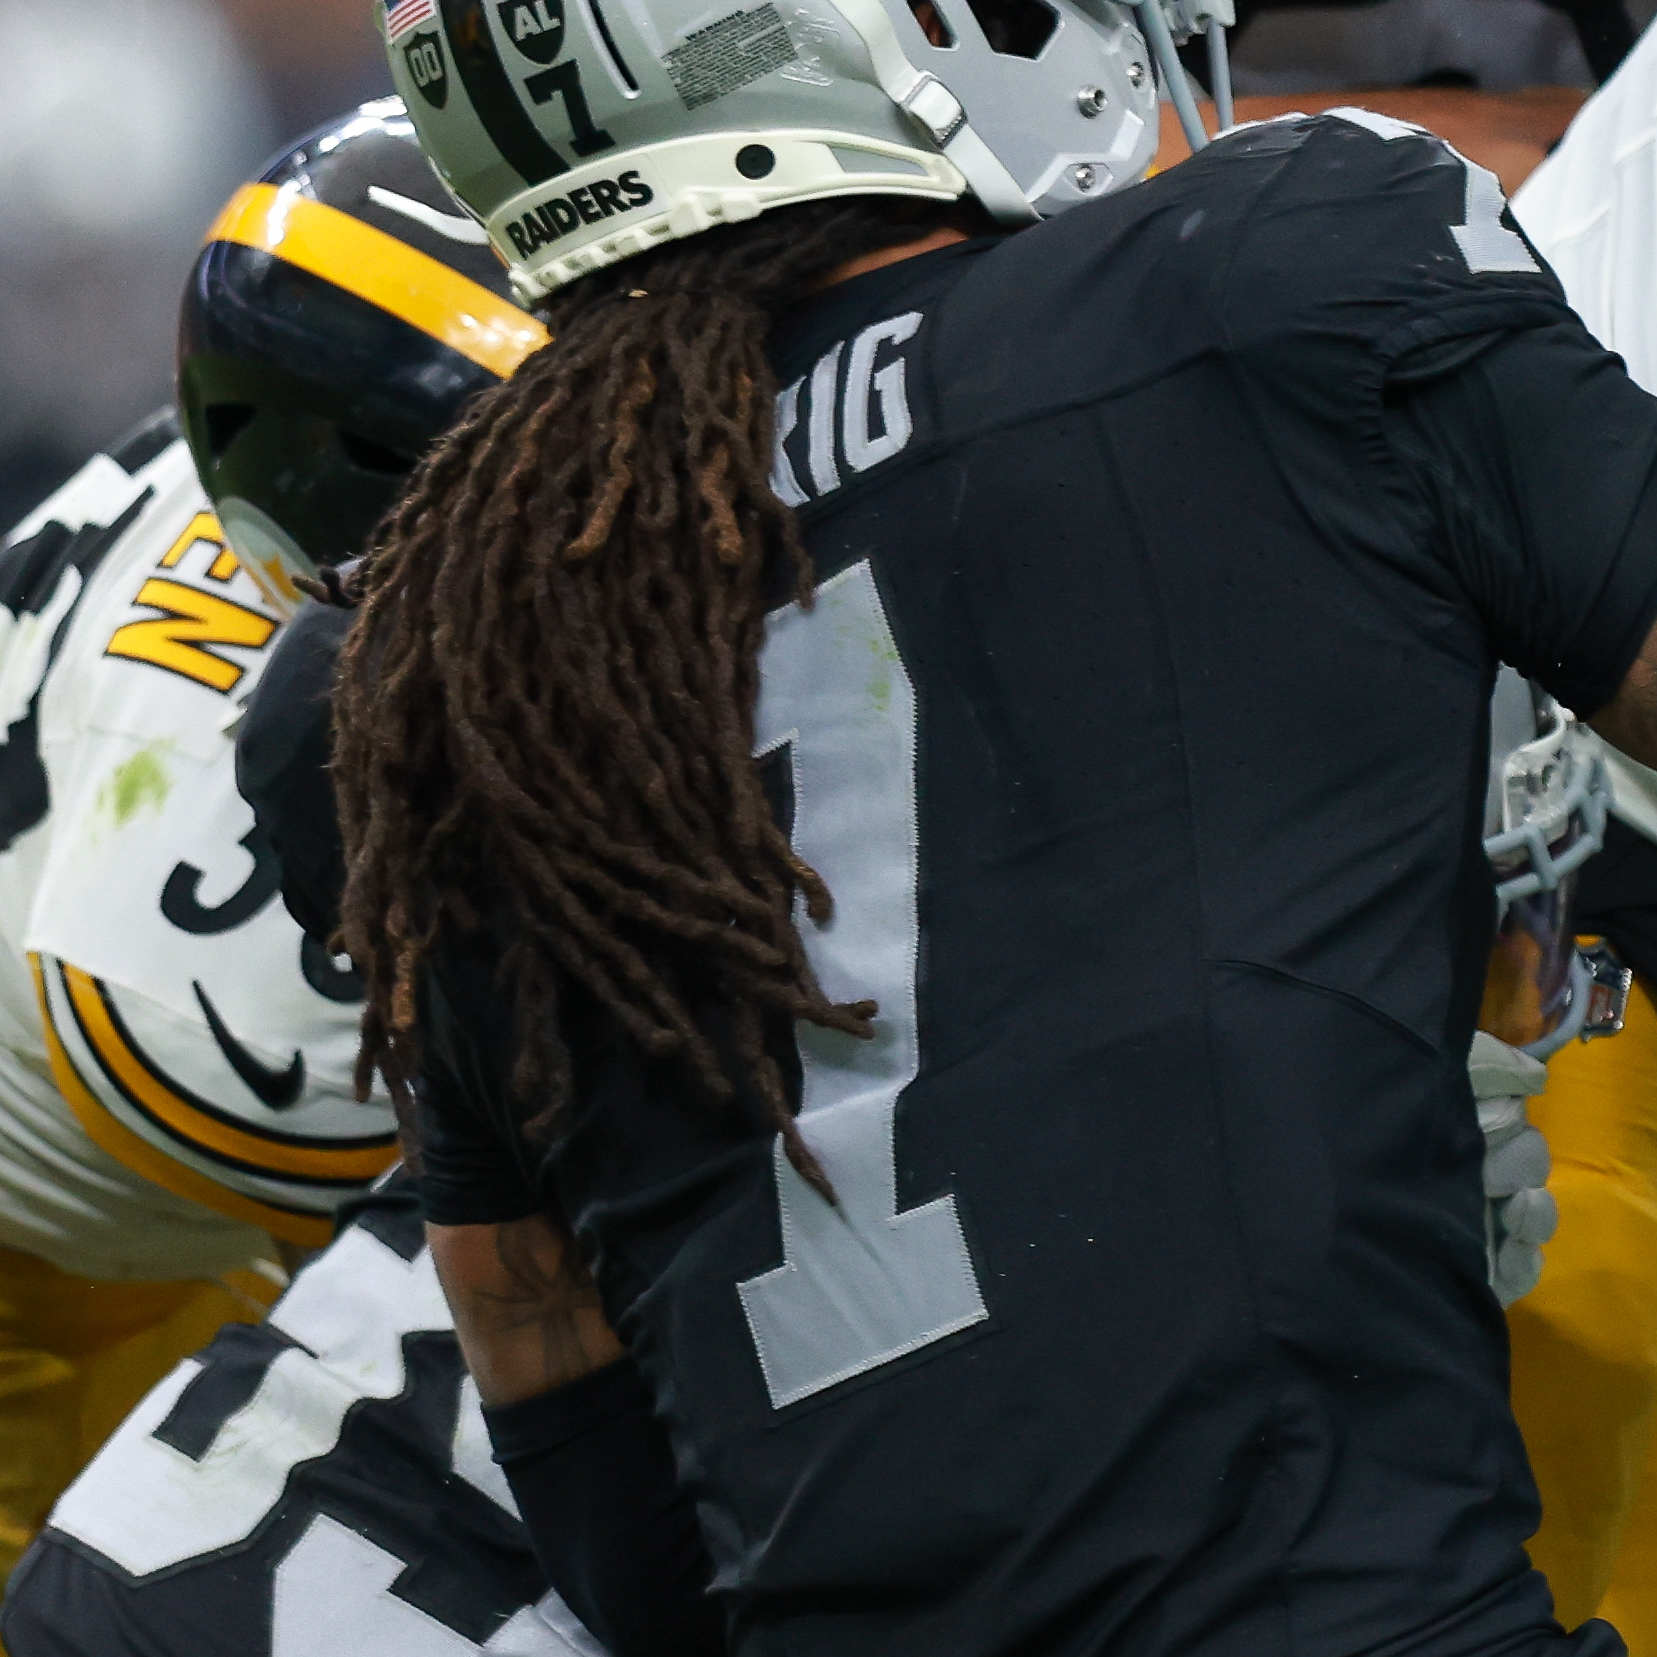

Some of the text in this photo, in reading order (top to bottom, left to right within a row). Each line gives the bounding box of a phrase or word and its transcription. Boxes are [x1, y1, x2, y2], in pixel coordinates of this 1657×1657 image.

[513, 0, 561, 42] AL
[523, 58, 617, 158] 7
[505, 170, 654, 261] RAIDERS
